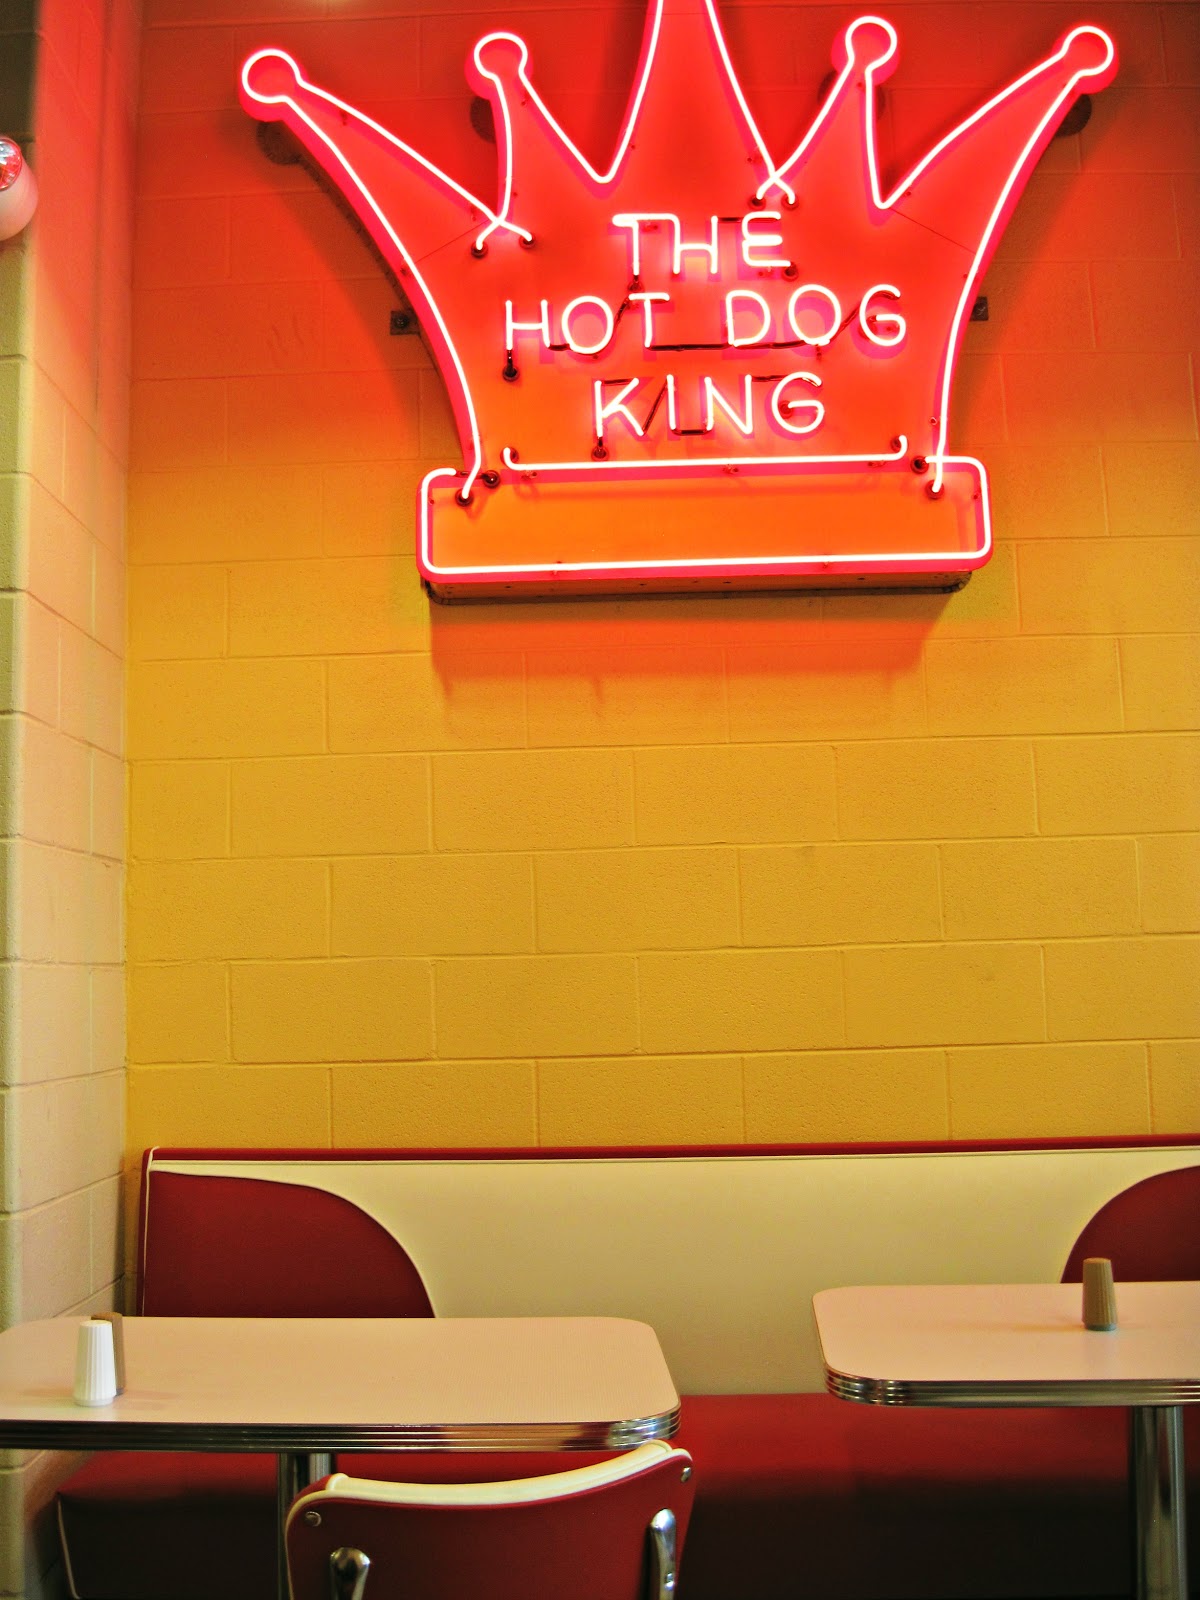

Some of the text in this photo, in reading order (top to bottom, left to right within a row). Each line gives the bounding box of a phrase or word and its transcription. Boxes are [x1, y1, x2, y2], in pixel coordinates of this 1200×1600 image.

[612, 211, 792, 275] THE
[505, 284, 907, 355] HOT DOG
[595, 371, 826, 438] KING
